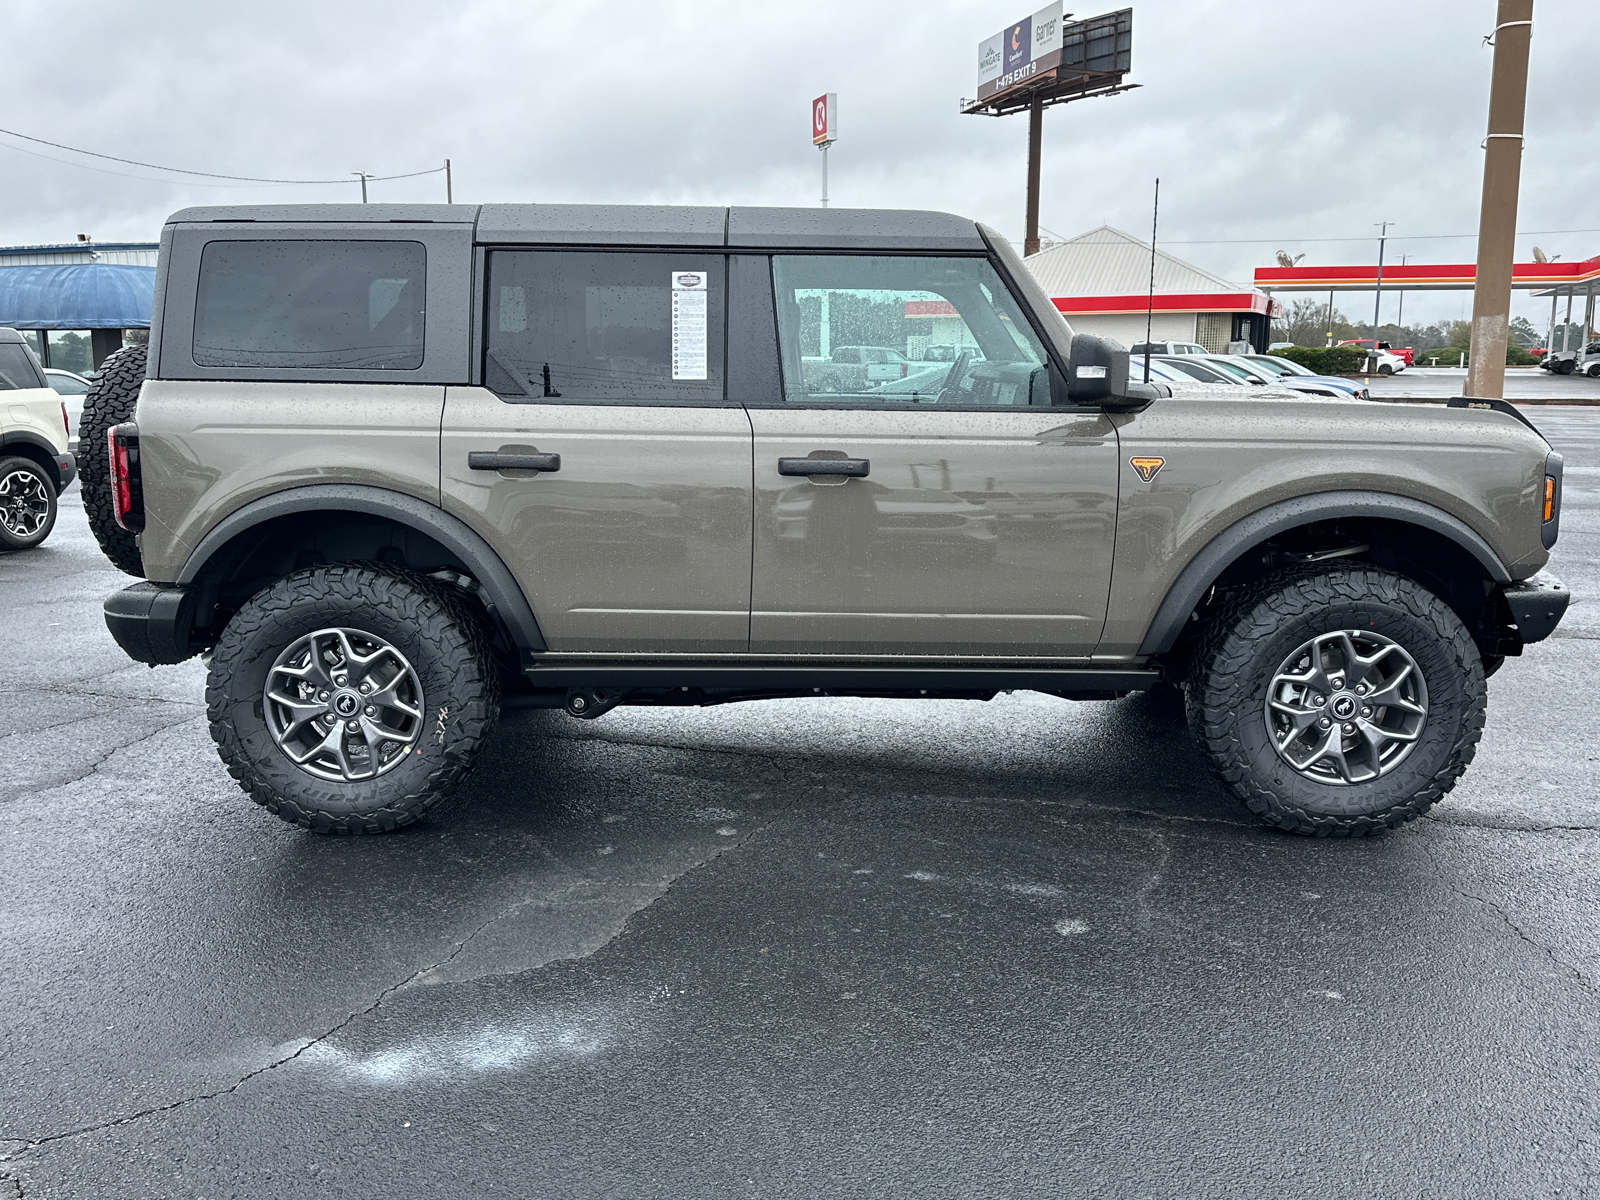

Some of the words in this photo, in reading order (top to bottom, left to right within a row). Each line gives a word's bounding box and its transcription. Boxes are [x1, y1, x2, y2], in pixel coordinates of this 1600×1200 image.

[980, 52, 1001, 69] WINGATE
[996, 72, 1013, 90] I-475
[1014, 63, 1031, 81] EXIT
[1031, 61, 1037, 74] 9
